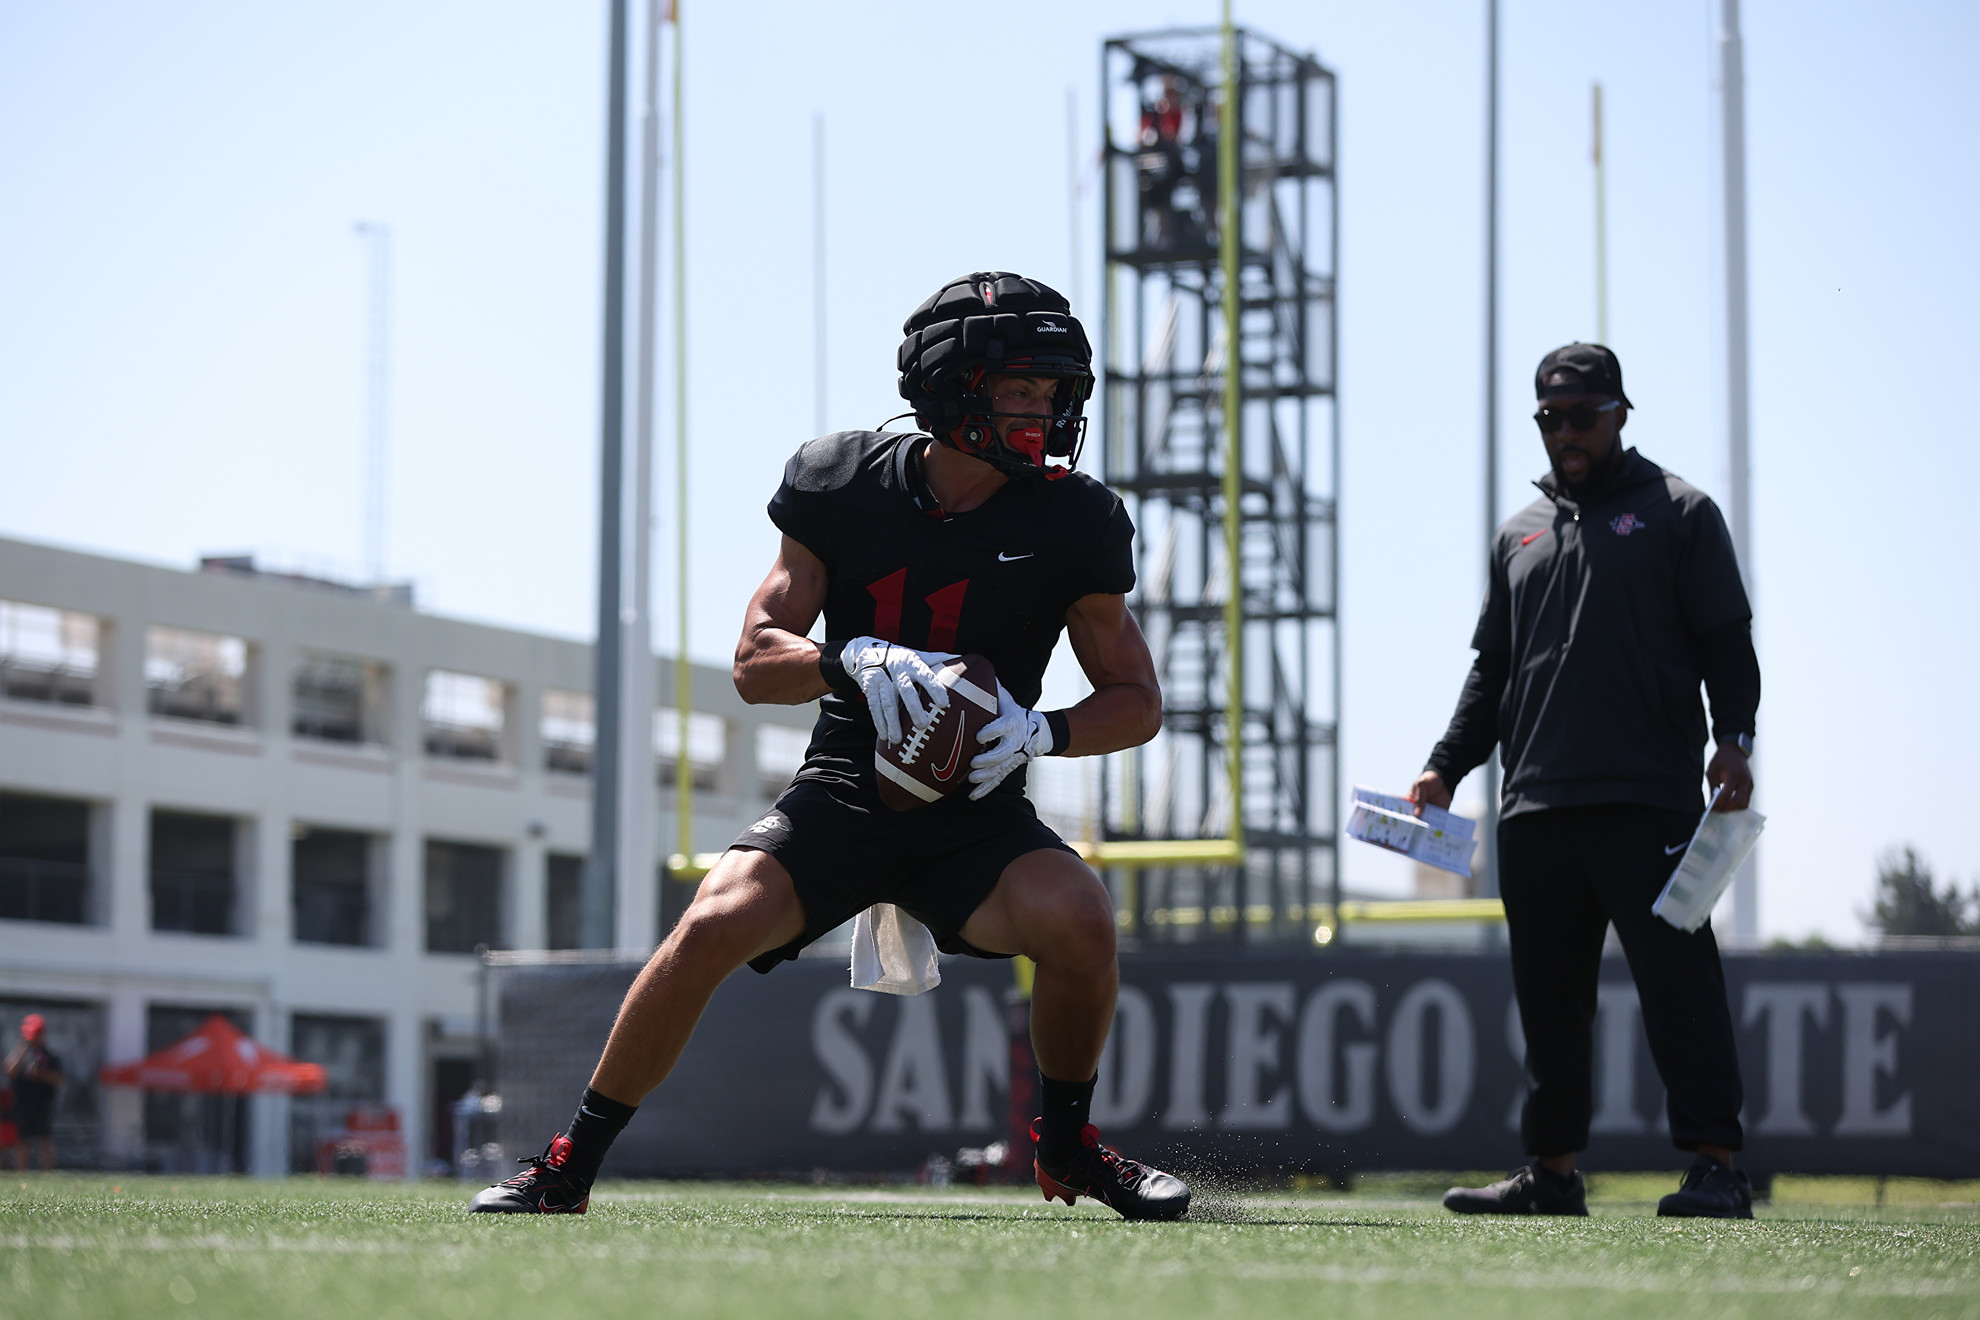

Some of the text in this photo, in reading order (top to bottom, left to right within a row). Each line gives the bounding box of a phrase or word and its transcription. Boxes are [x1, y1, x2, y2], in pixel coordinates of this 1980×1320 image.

[865, 567, 970, 653] 11
[810, 984, 1011, 1134] SAN
[1088, 980, 1476, 1135] DIEGO
